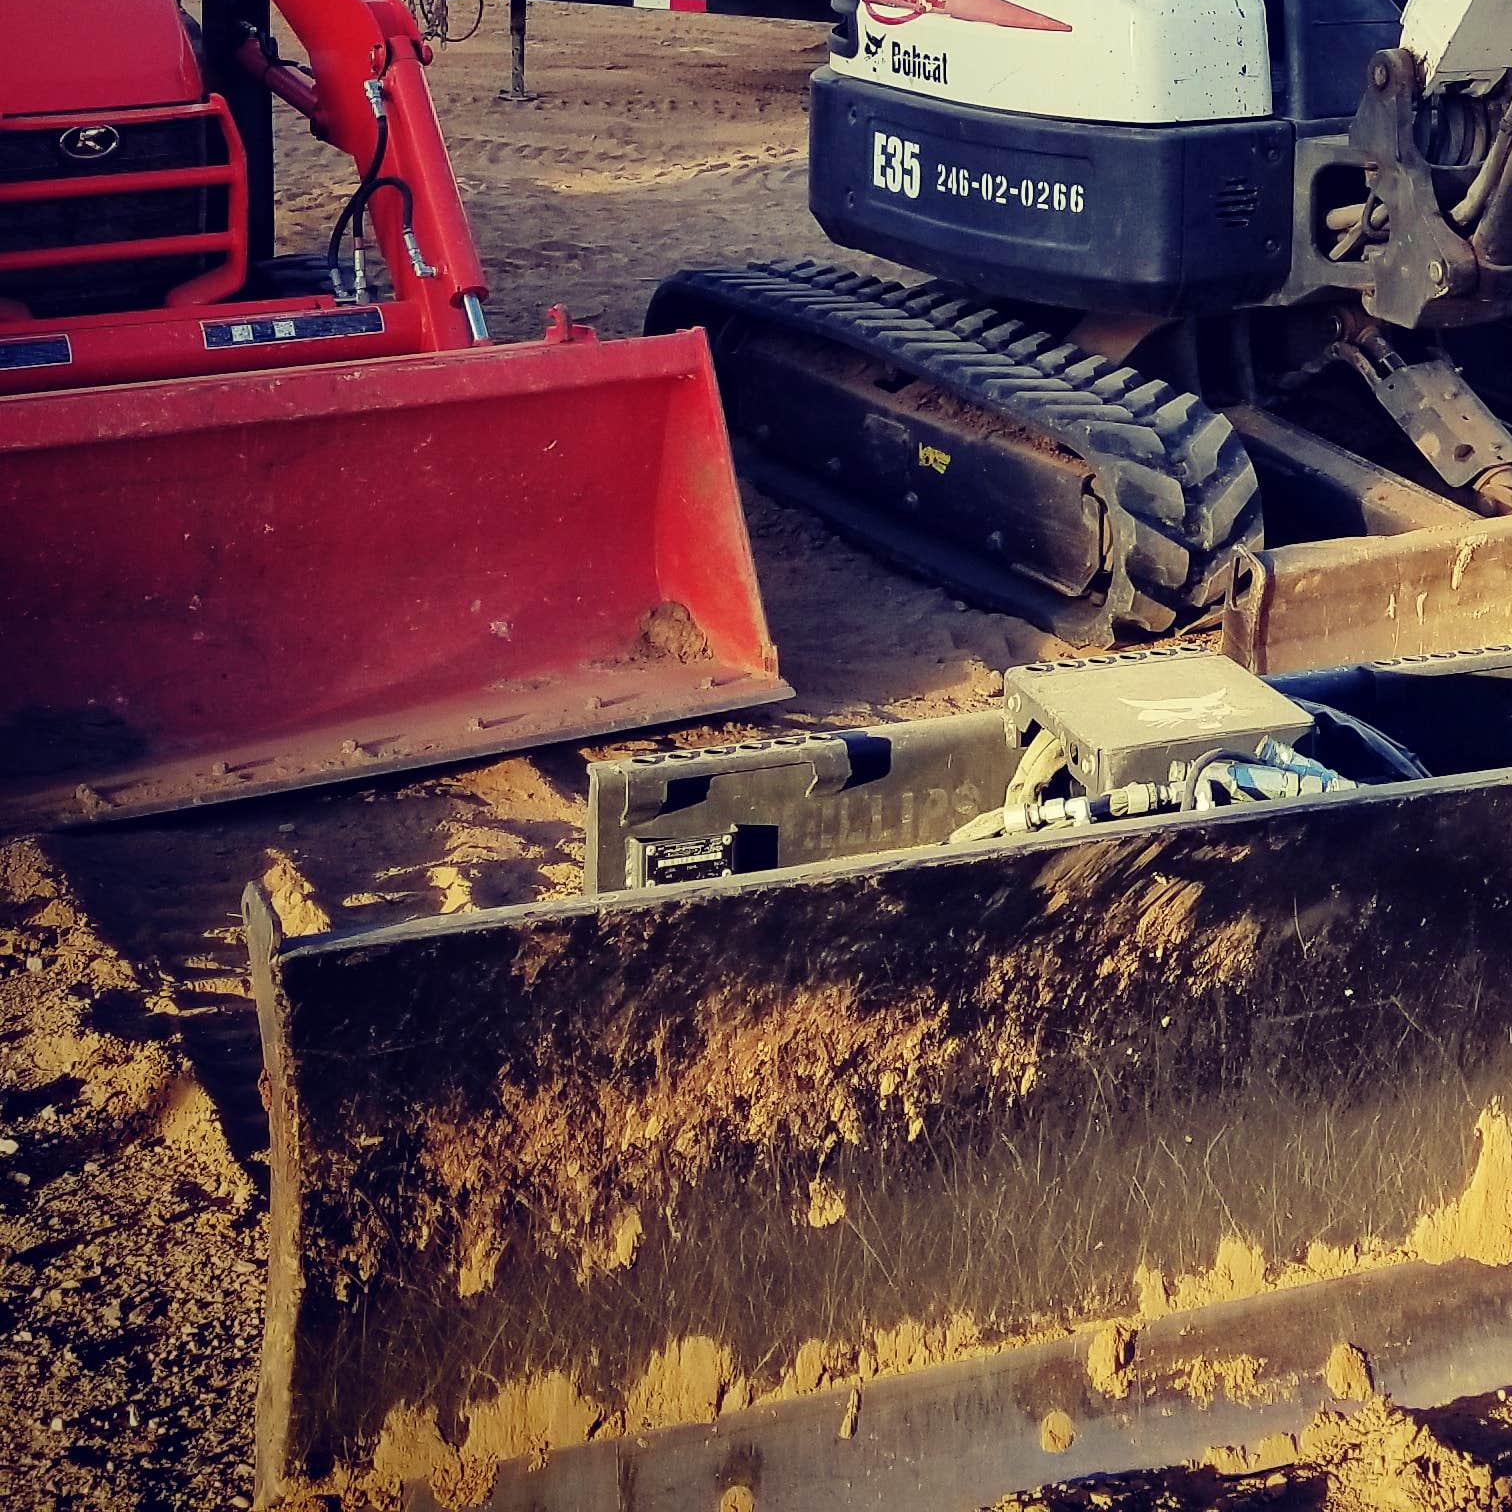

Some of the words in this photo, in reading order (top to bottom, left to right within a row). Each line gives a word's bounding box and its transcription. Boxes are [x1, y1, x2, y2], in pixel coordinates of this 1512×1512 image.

[892, 41, 948, 84] Bobcat
[873, 131, 921, 199] E35
[936, 163, 1085, 213] 246-02-0266
